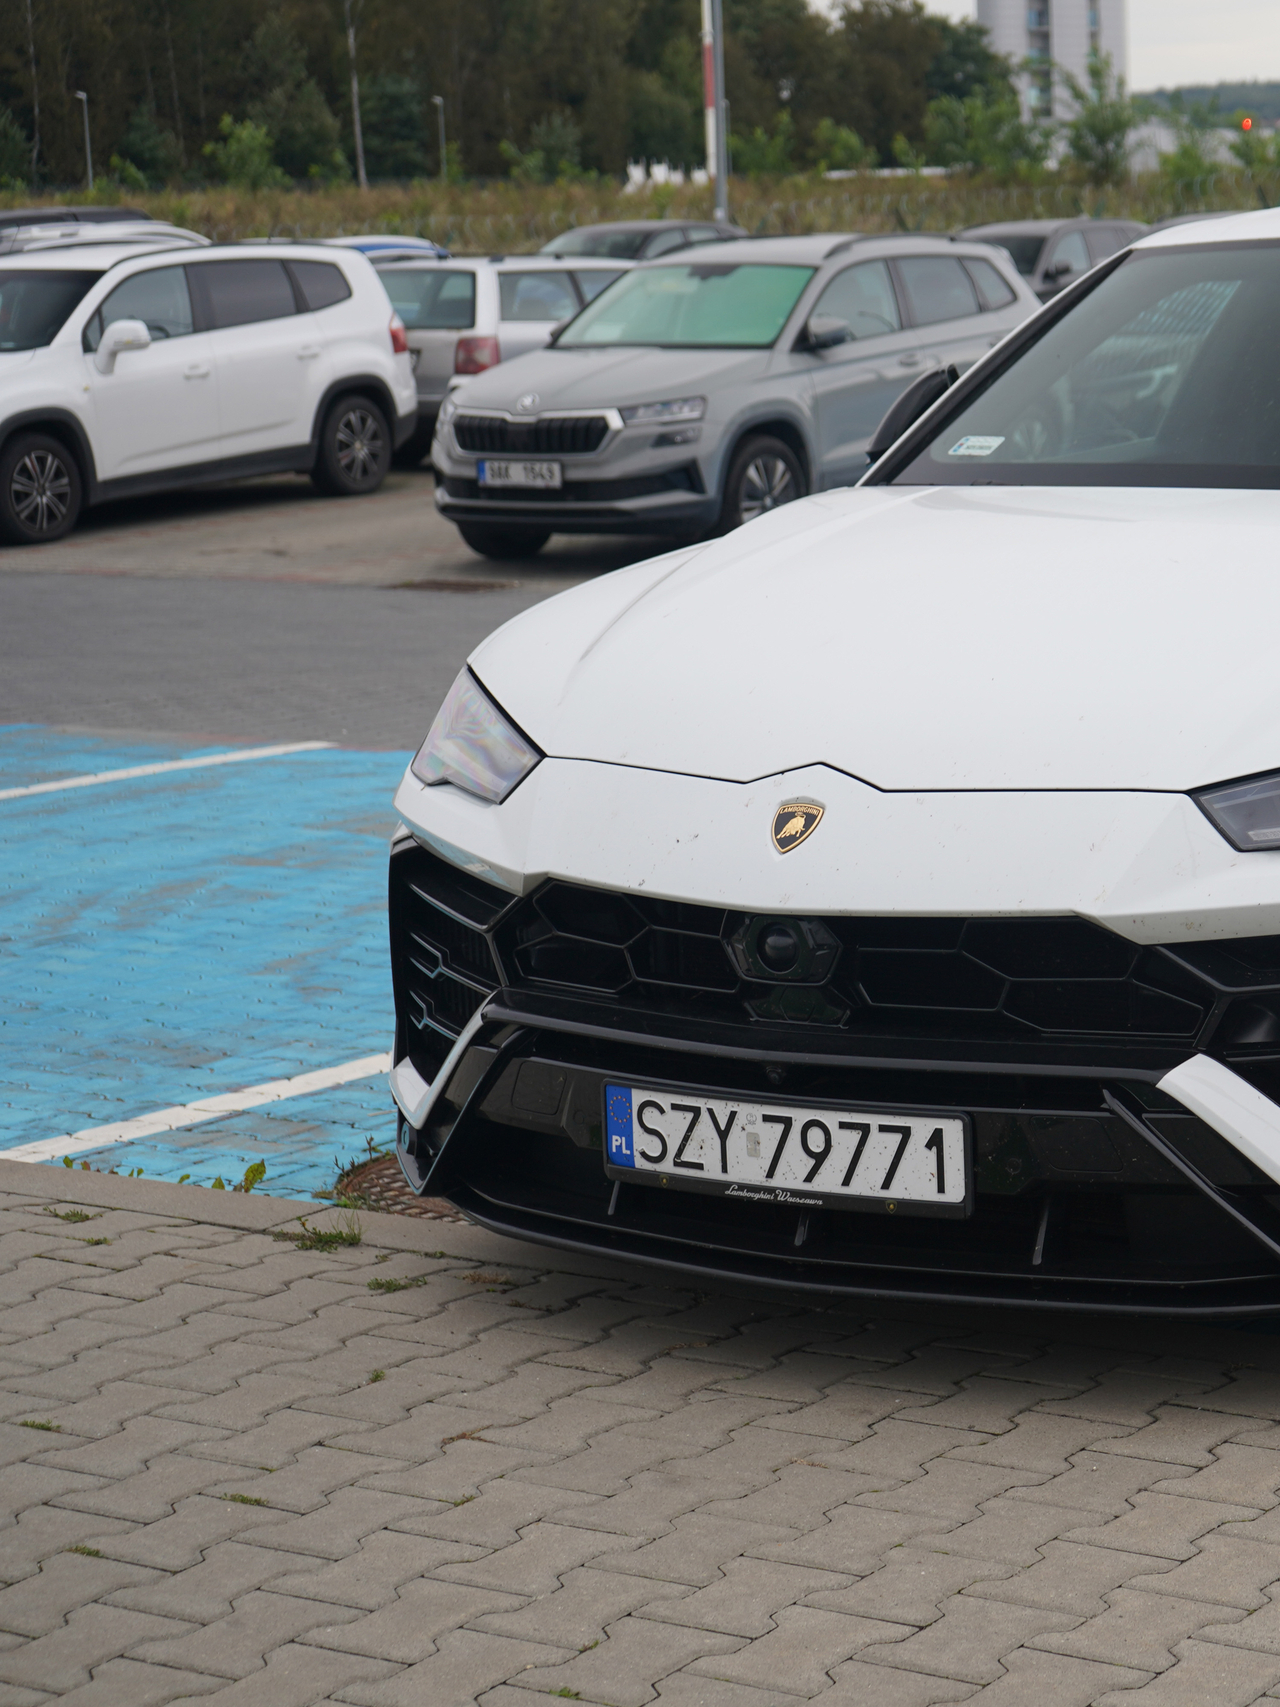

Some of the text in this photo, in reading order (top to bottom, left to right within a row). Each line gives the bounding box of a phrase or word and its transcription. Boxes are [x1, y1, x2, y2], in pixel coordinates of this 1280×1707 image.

[780, 806, 820, 816] LAMBORGHINI
[611, 1134, 631, 1155] PL
[637, 1099, 945, 1194] SZY 79771
[725, 1184, 823, 1205] Lamborghini Warszawa
